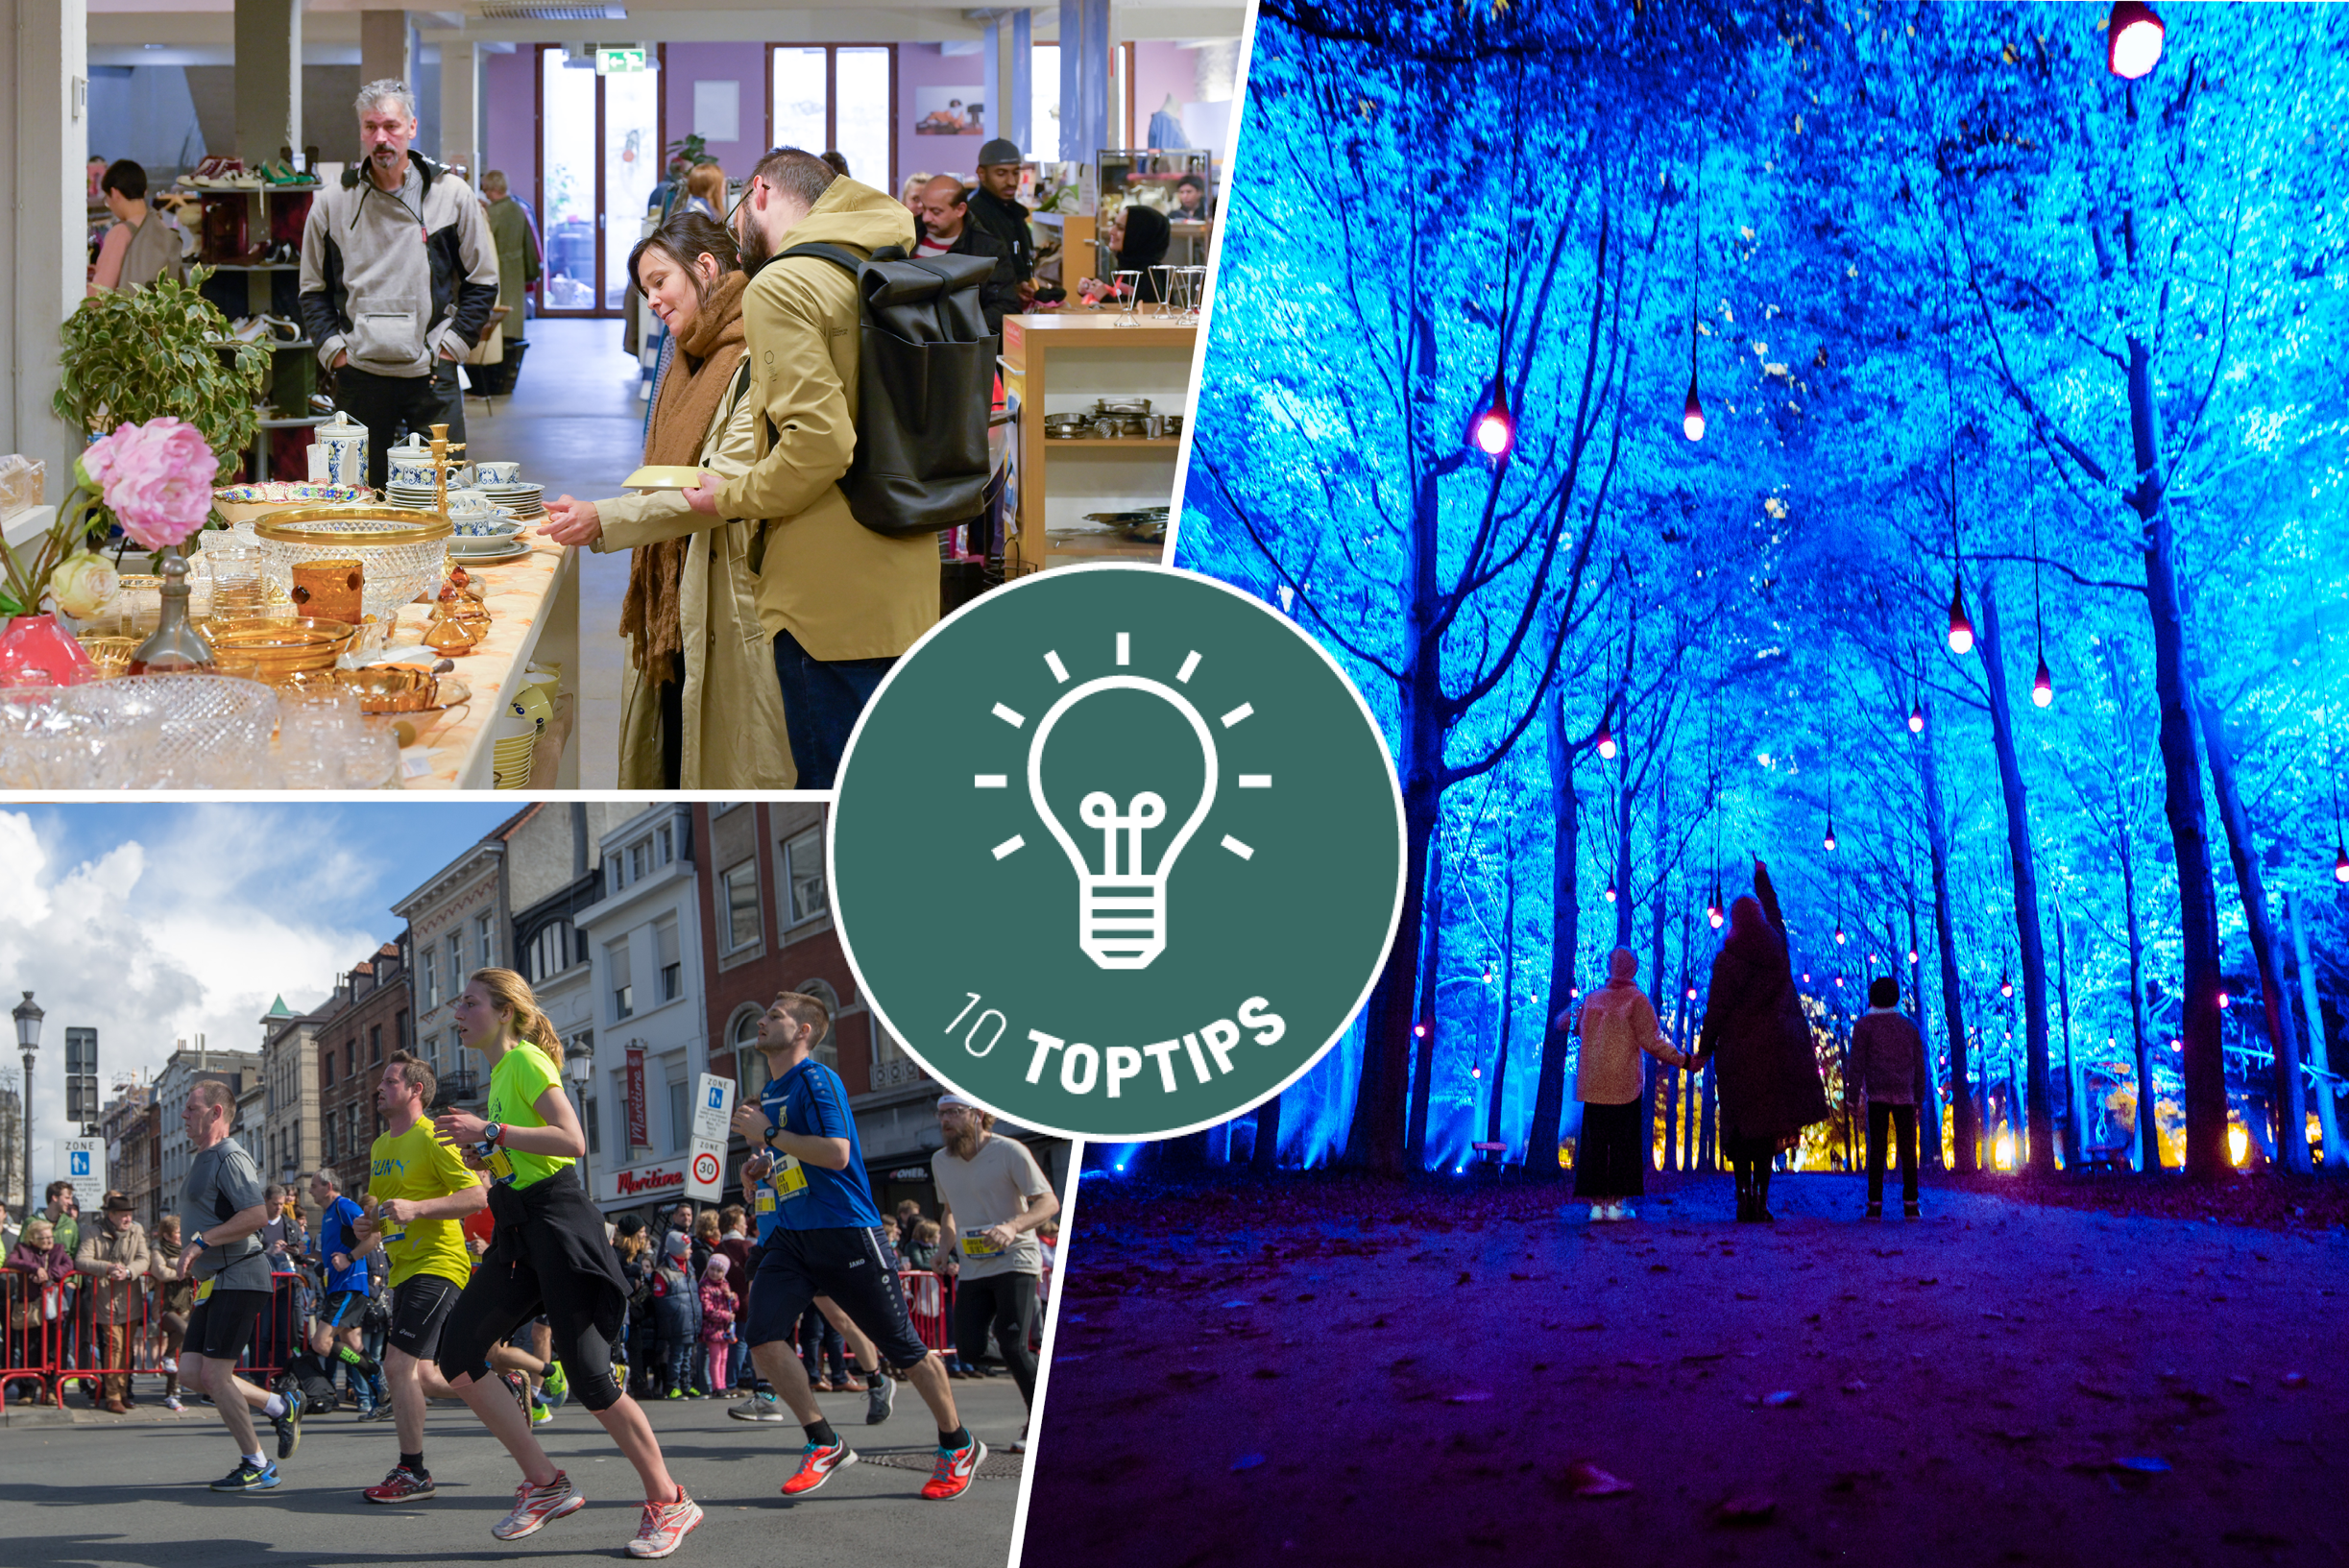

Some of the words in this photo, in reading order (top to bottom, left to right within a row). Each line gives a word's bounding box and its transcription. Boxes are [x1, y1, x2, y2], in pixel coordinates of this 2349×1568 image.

[707, 1077, 729, 1090] ZONE
[630, 1070, 645, 1141] Maritime
[64, 1141, 95, 1150] ZONE
[699, 1141, 719, 1152] ZONE
[699, 1161, 714, 1175] 30
[617, 1168, 685, 1195] Maritime
[849, 1258, 865, 1268] JAKO
